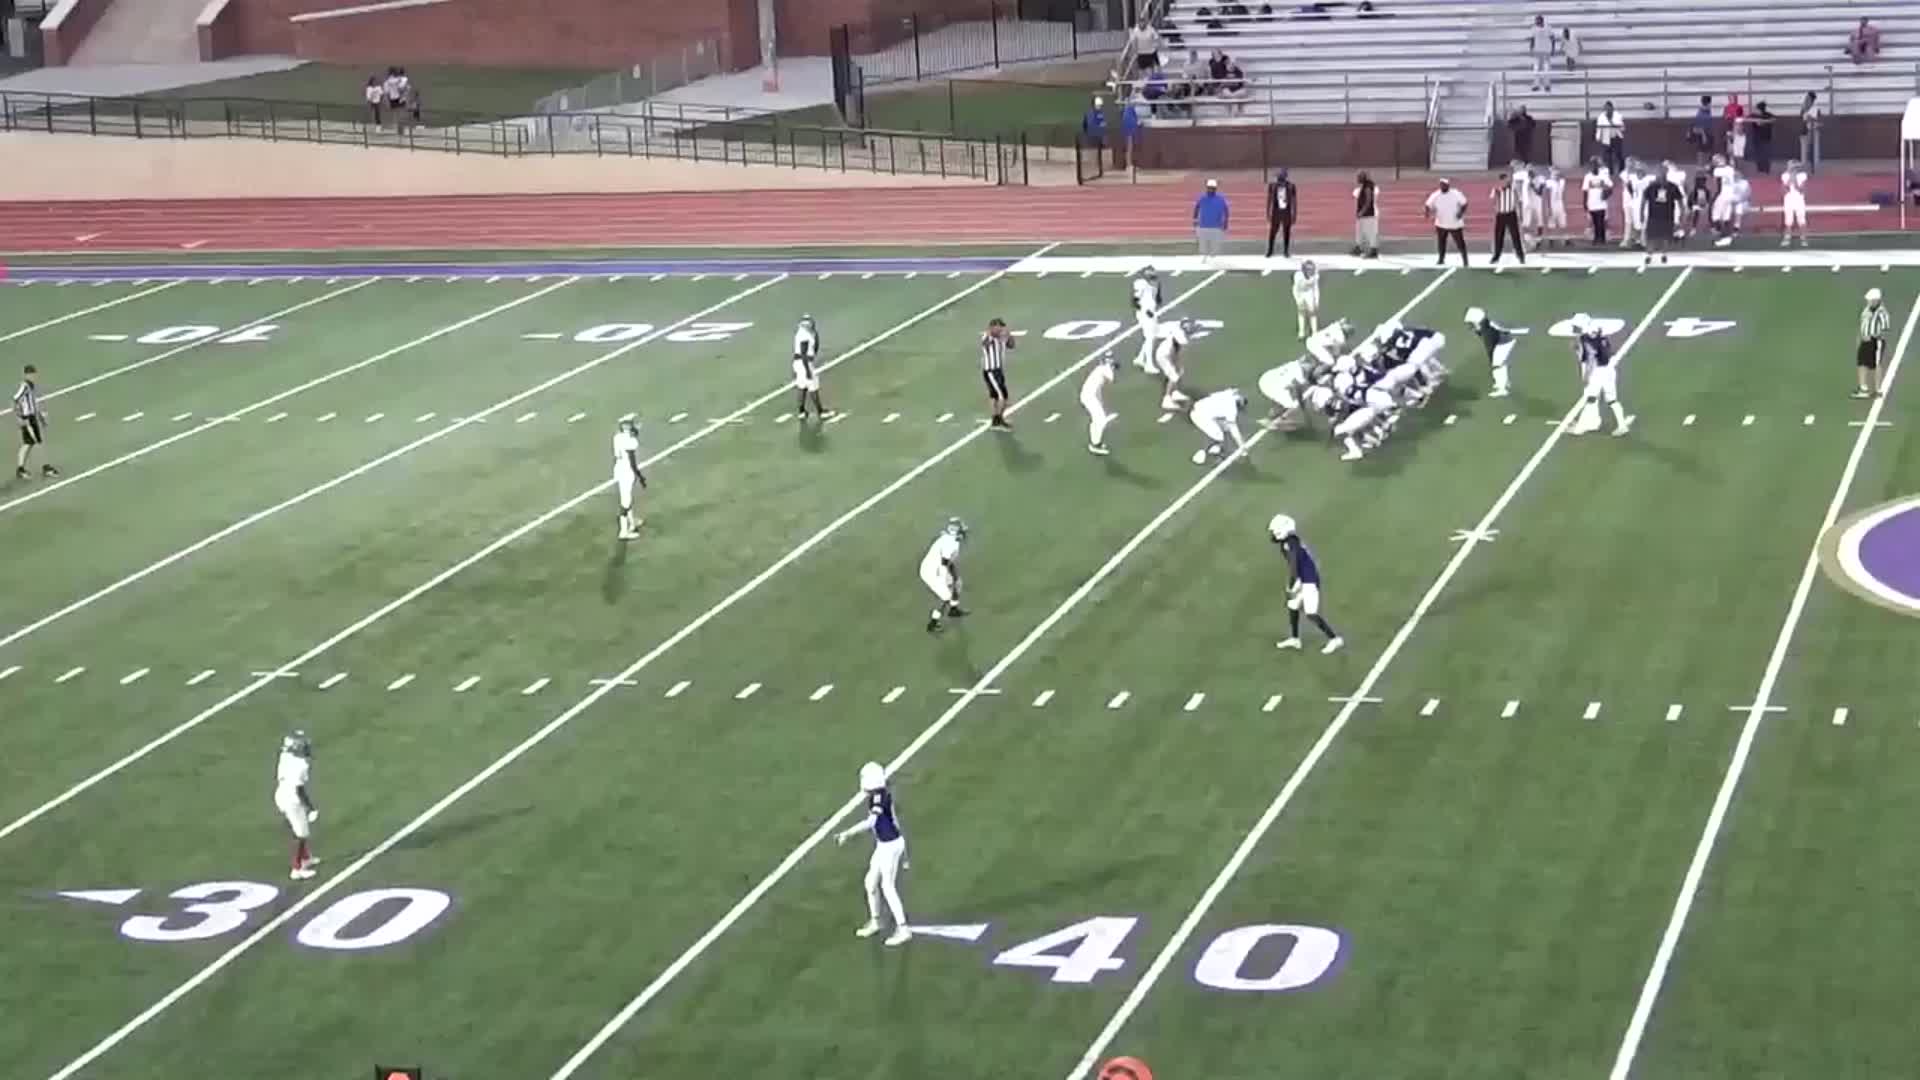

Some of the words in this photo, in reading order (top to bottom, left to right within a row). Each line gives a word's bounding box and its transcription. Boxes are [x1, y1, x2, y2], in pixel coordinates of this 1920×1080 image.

[573, 322, 754, 341] 20
[121, 881, 450, 949] 30
[992, 916, 1340, 990] 40
